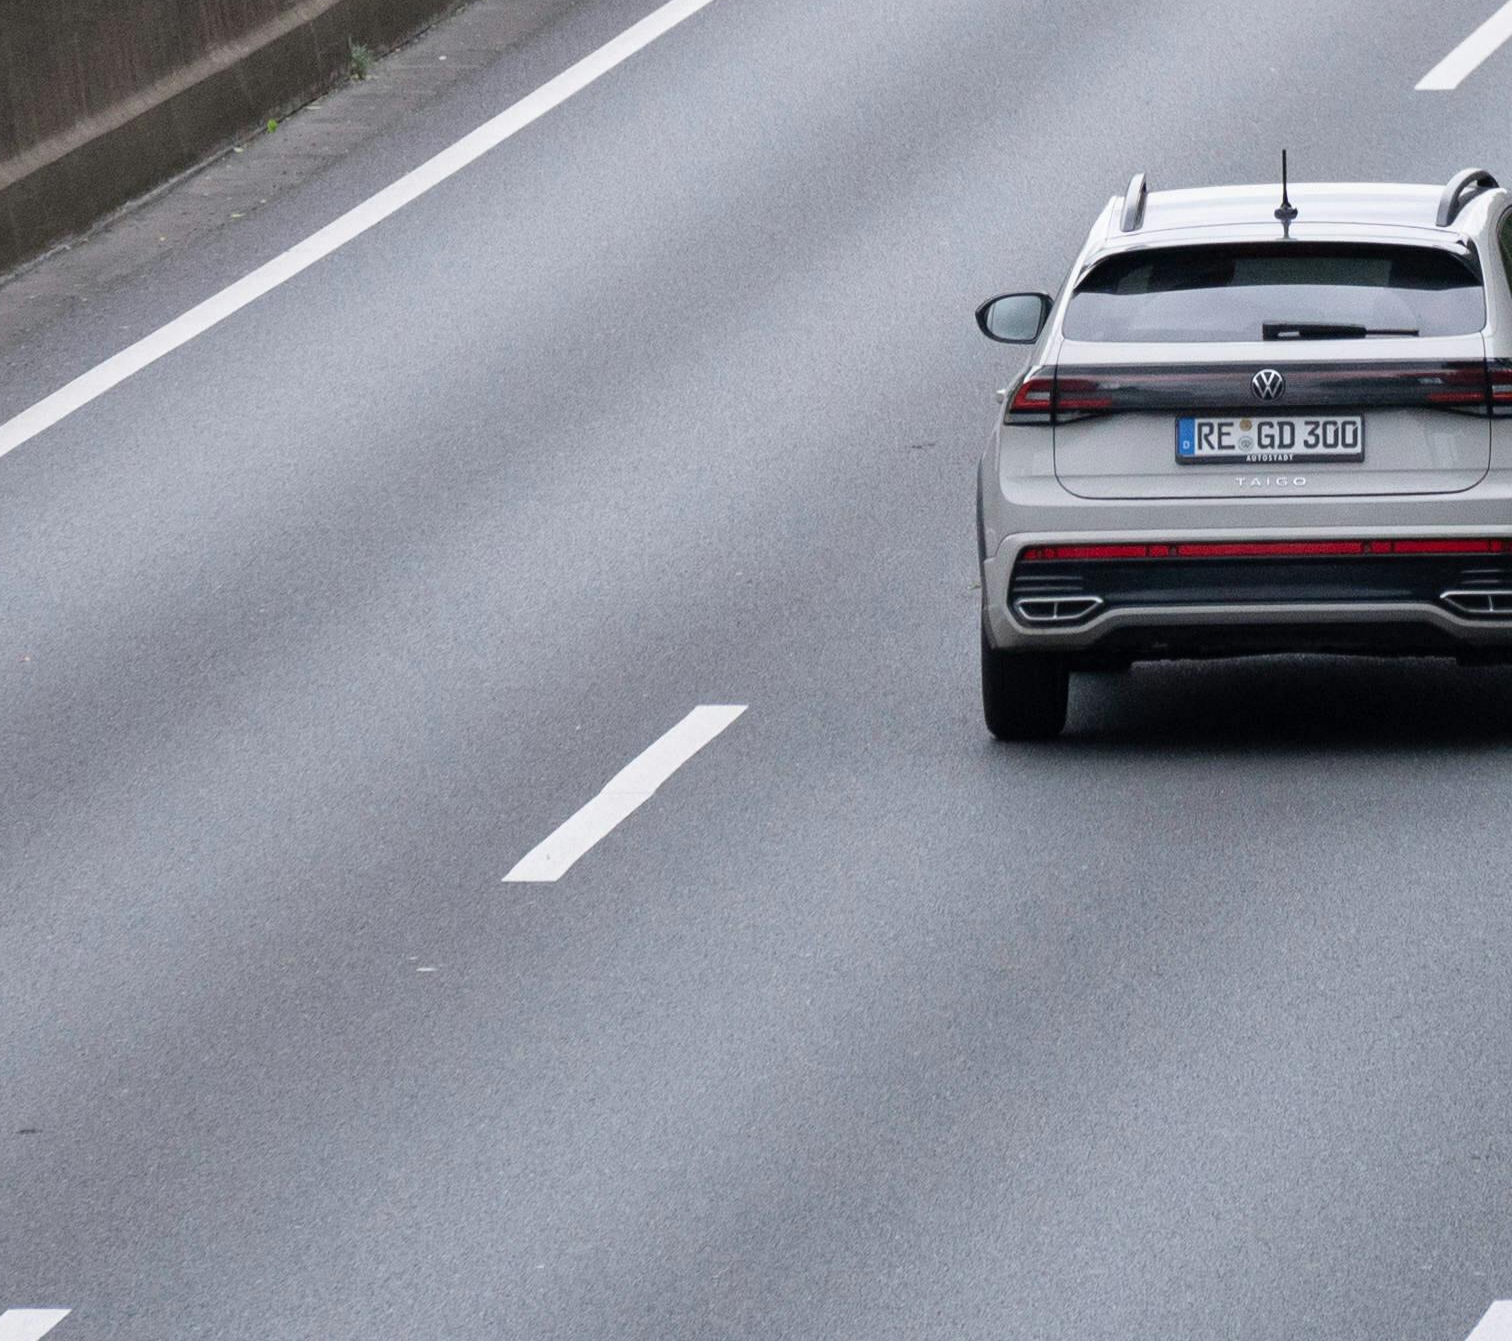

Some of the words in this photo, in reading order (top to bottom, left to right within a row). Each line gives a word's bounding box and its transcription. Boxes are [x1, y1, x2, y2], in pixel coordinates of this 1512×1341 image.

[1197, 421, 1236, 451] RE
[1257, 420, 1296, 450] GD
[1303, 420, 1359, 450] 300
[1236, 476, 1307, 487] TAIGO
